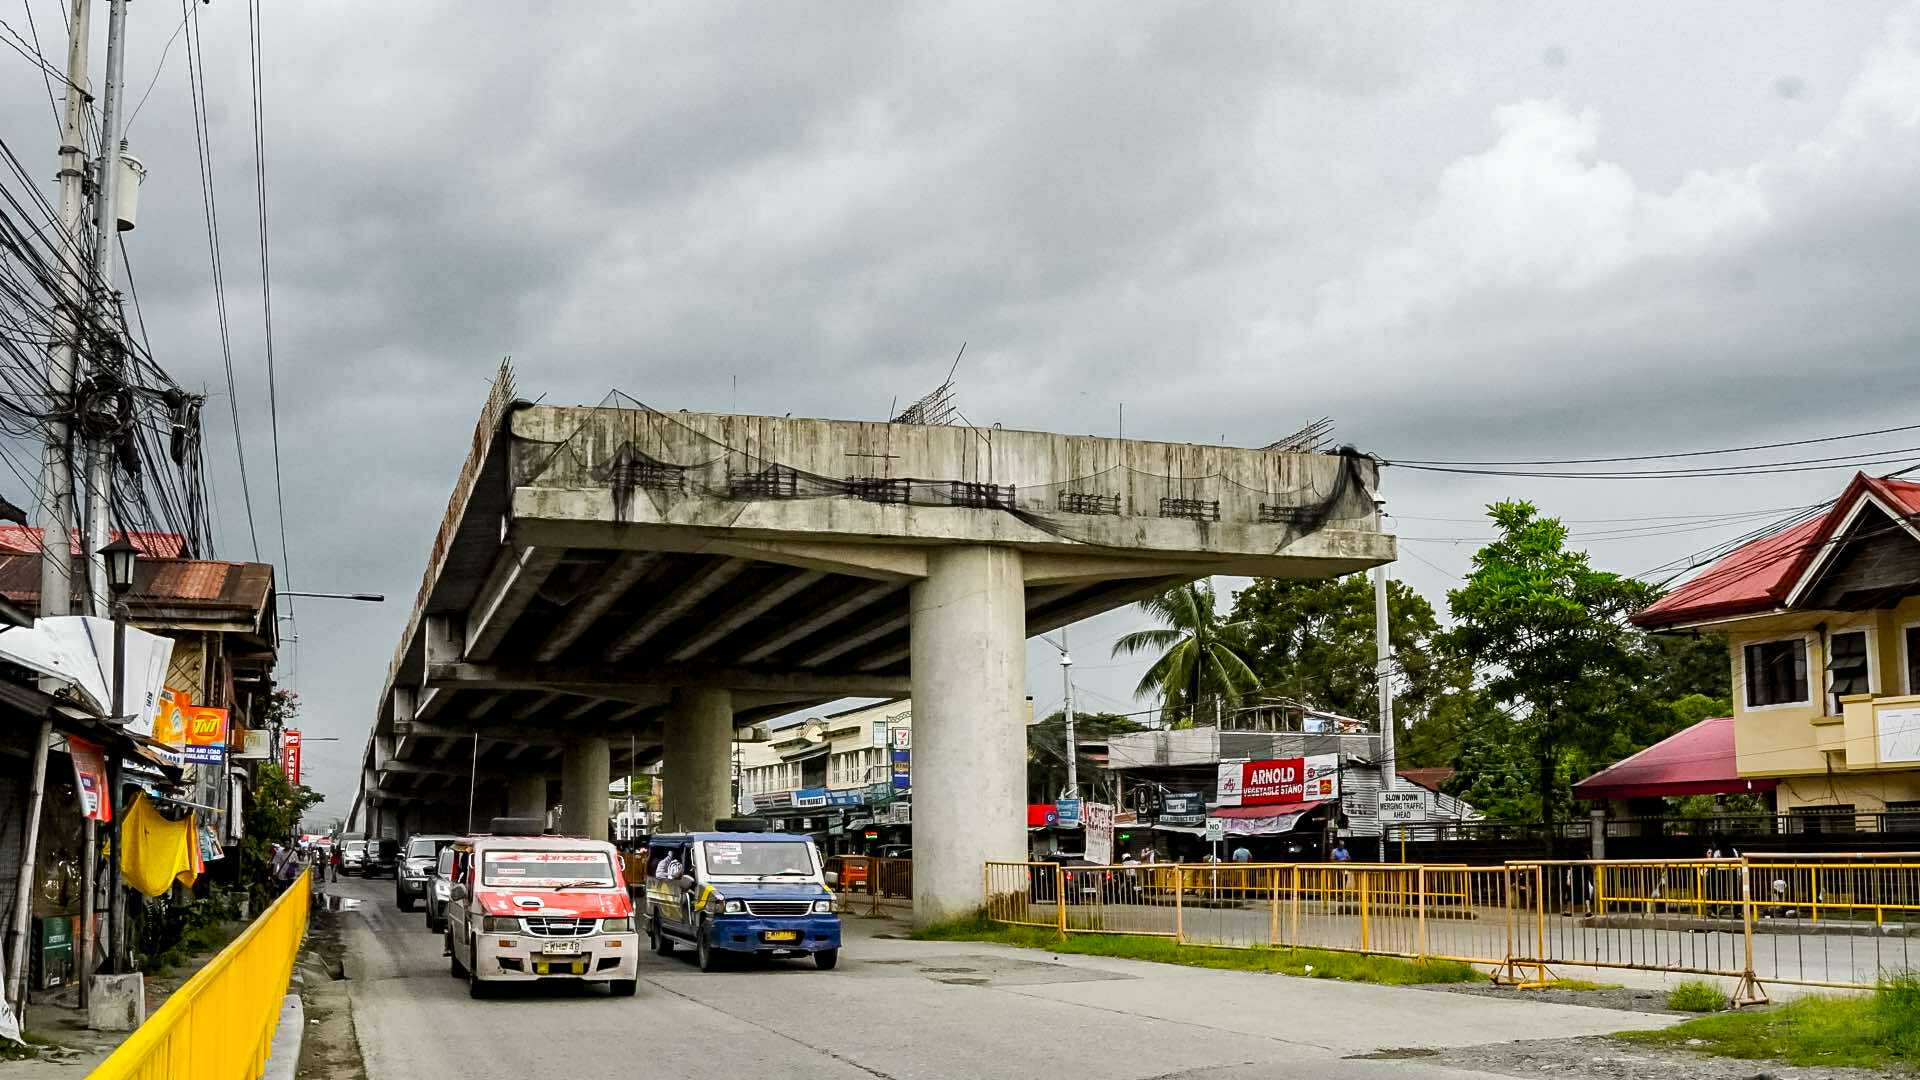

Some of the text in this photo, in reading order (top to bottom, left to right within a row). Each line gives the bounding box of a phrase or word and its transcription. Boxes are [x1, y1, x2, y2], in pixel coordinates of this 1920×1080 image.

[1250, 767, 1295, 785] ARNOLD
[1243, 786, 1280, 797] VEGETABLE
[1280, 784, 1303, 795] STAND
[1404, 802, 1424, 810] TRAFFIC
[1393, 811, 1411, 819] AHEAD
[1209, 823, 1220, 831] NO
